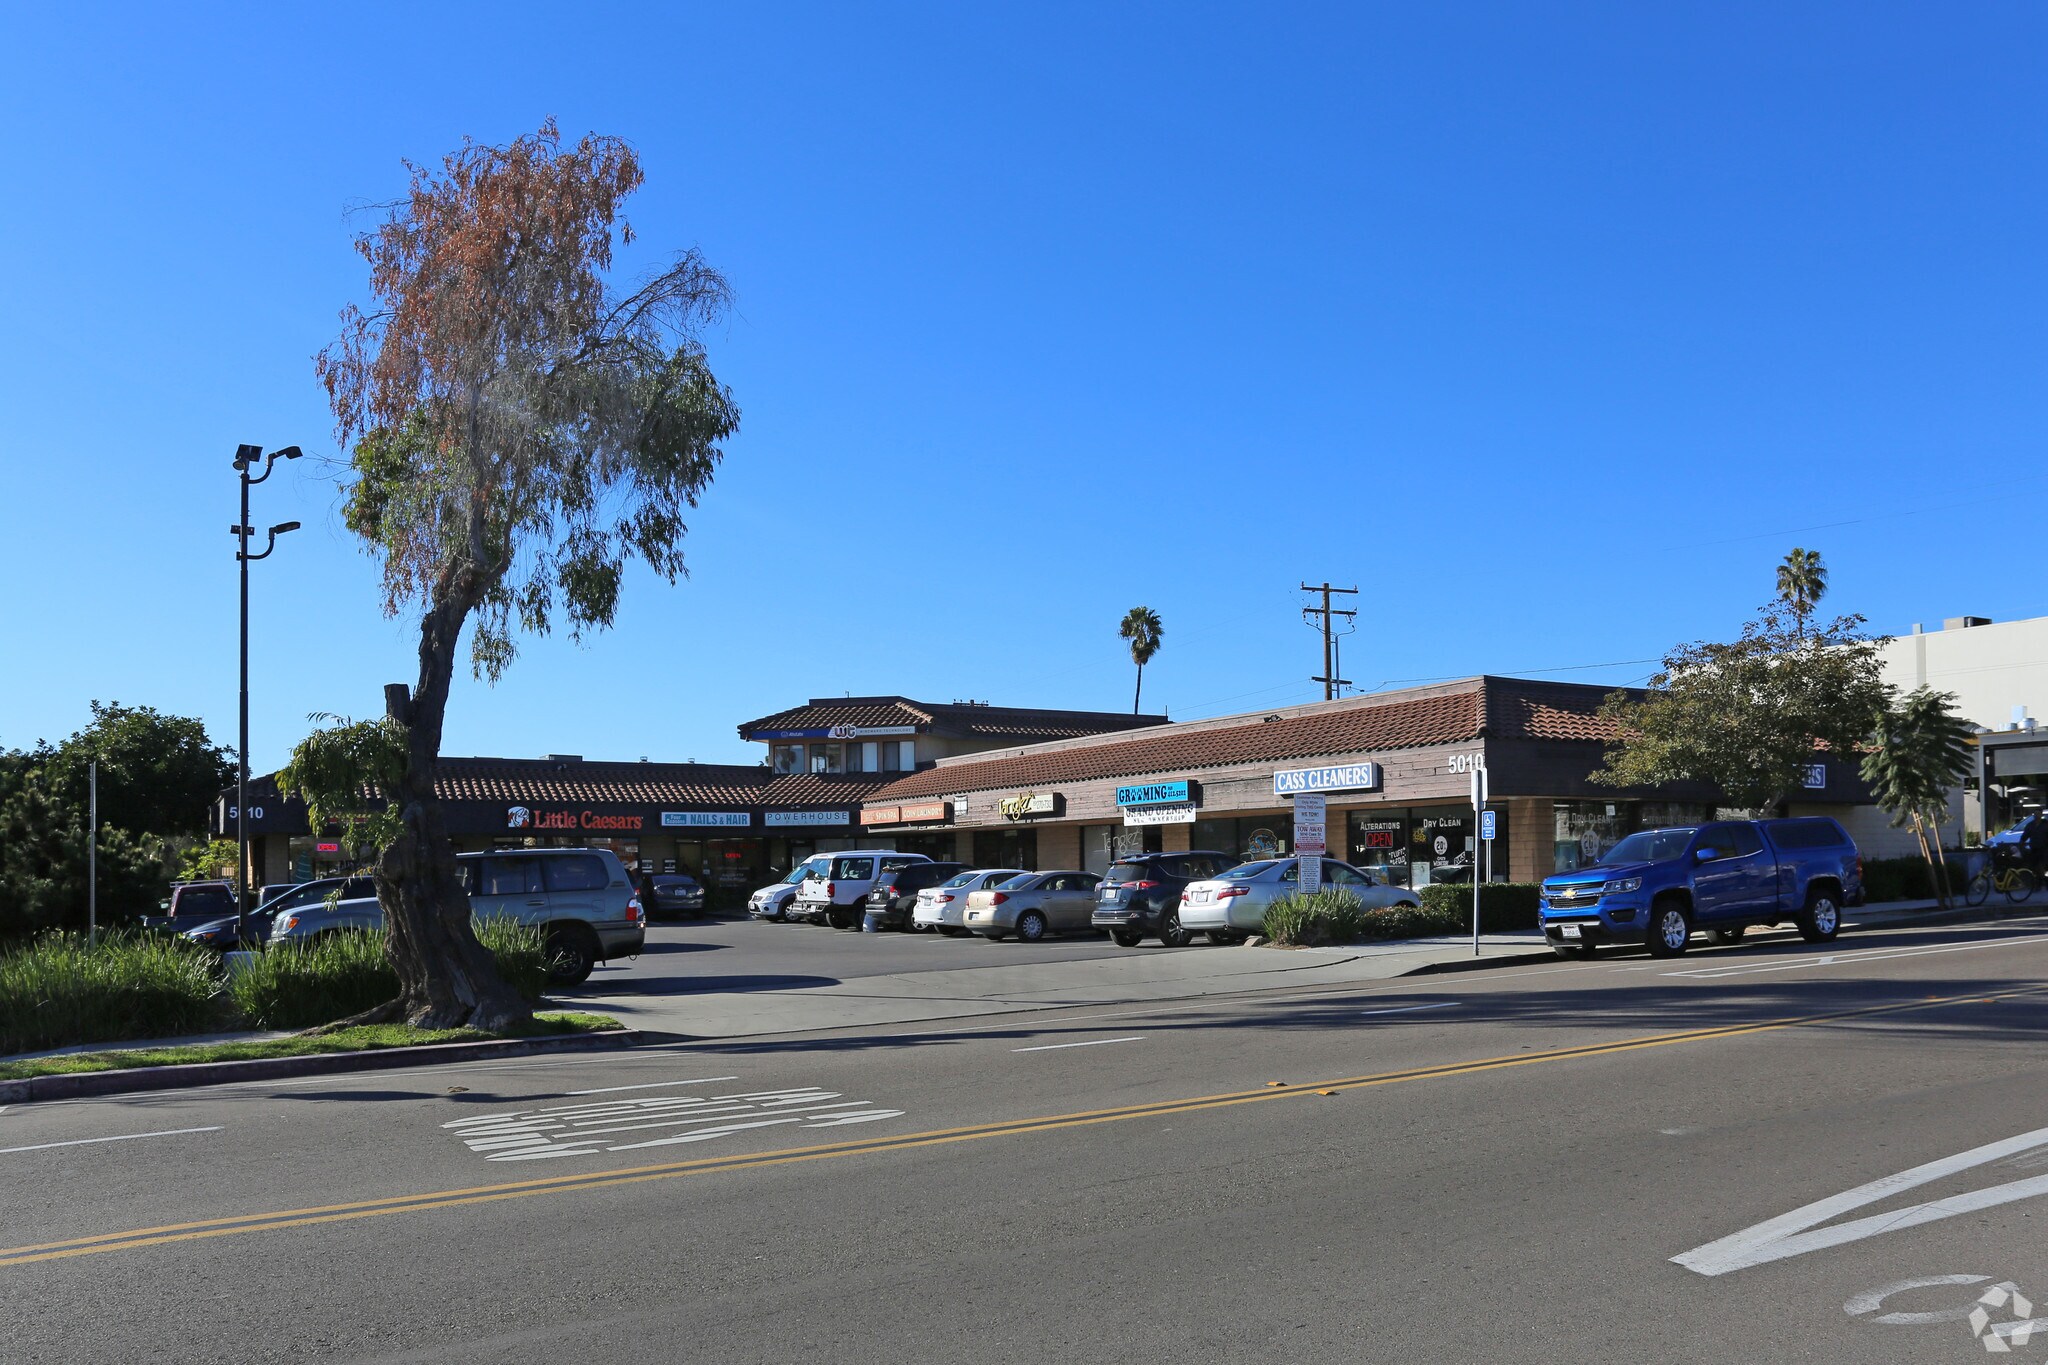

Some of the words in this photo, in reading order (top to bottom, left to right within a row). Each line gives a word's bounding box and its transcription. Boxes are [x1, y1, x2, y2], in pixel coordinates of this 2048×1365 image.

[1448, 753, 1484, 774] 5010
[1277, 771, 1305, 791] CASS
[1308, 766, 1369, 788] CLEANERS
[229, 806, 264, 819] 510
[767, 811, 848, 821] POWERHOUSE
[1125, 805, 1154, 818] GRAND
[1155, 803, 1194, 816] OPENING
[533, 809, 577, 829] Little
[580, 810, 643, 829] Caesars
[690, 814, 718, 825] NAILS
[719, 816, 725, 825] &
[726, 814, 748, 825] HAIR
[1423, 819, 1437, 828] DRY
[1439, 817, 1462, 828] CLEAN
[1366, 832, 1393, 847] OPEN
